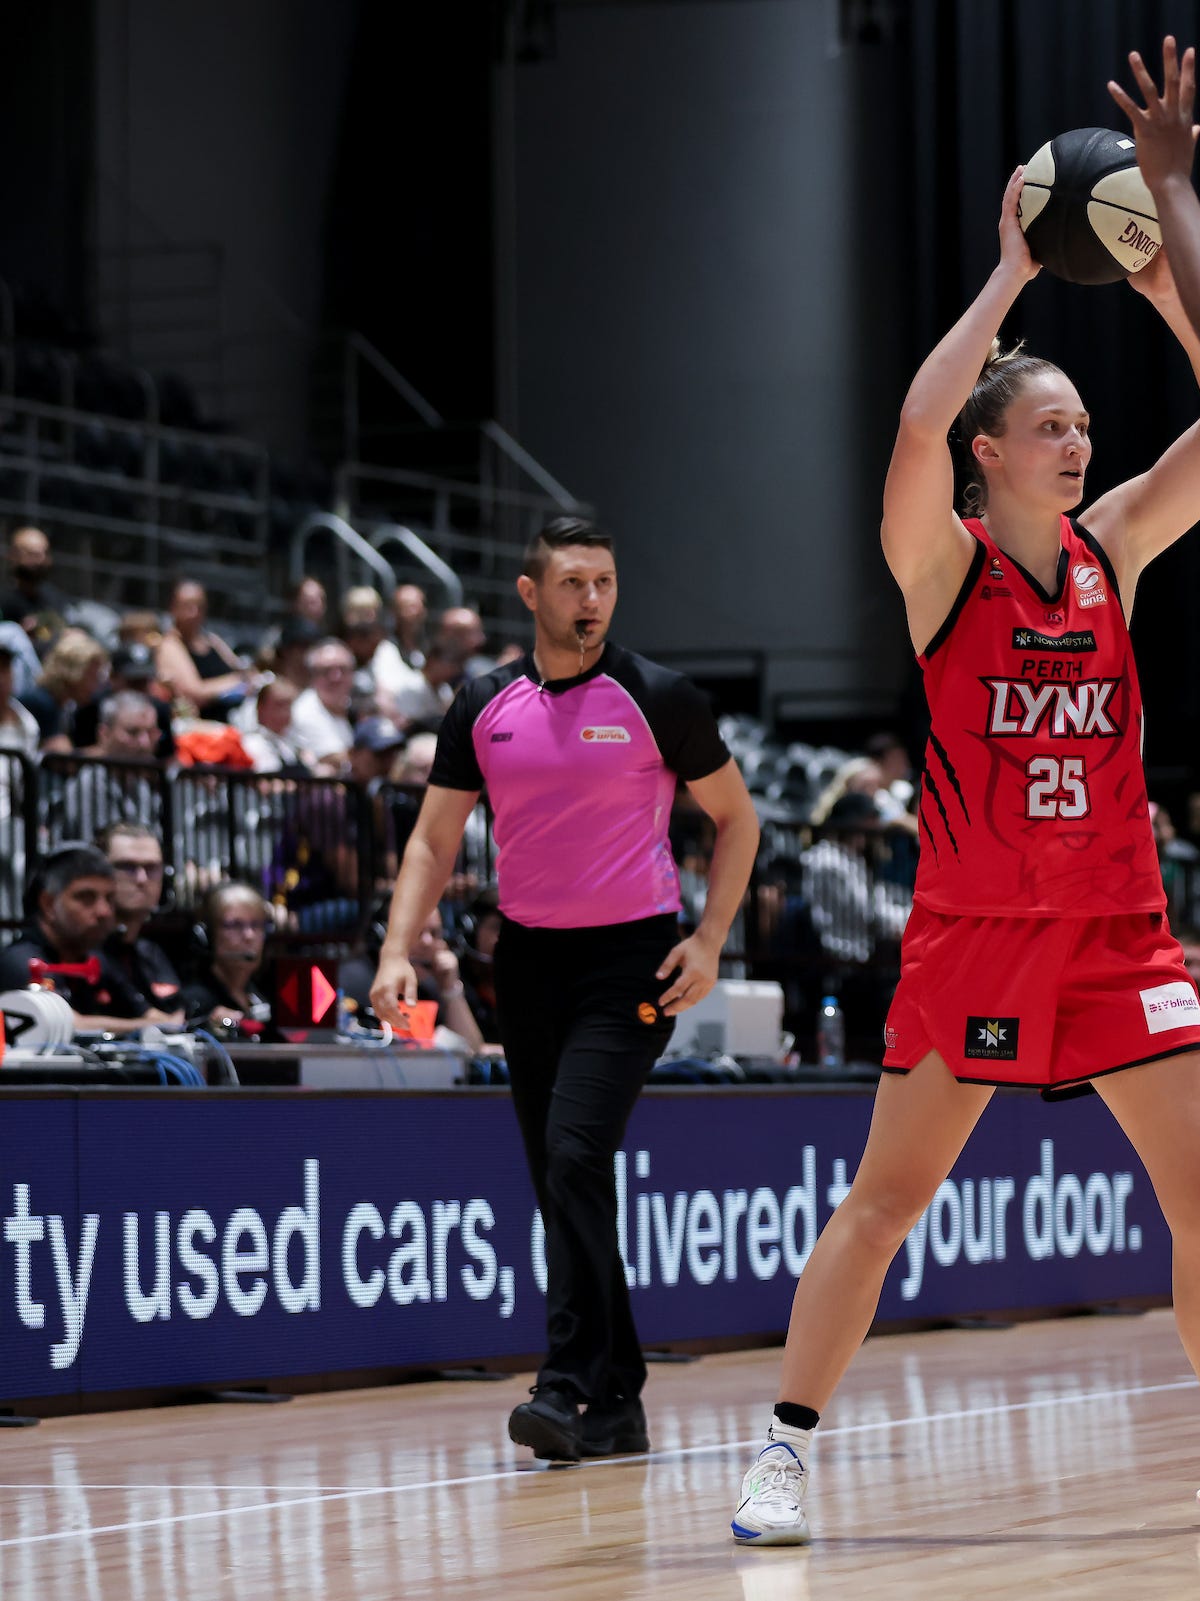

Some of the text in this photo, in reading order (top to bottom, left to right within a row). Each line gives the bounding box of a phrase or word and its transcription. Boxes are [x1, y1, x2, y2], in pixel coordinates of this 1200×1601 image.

[1020, 659, 1083, 679] PERTH
[984, 679, 1119, 736] LYNX
[1026, 755, 1091, 820] 25
[122, 1158, 321, 1322] used
[341, 1198, 515, 1318] cars,
[531, 1144, 818, 1294] livered
[1022, 1138, 1143, 1260] door.
